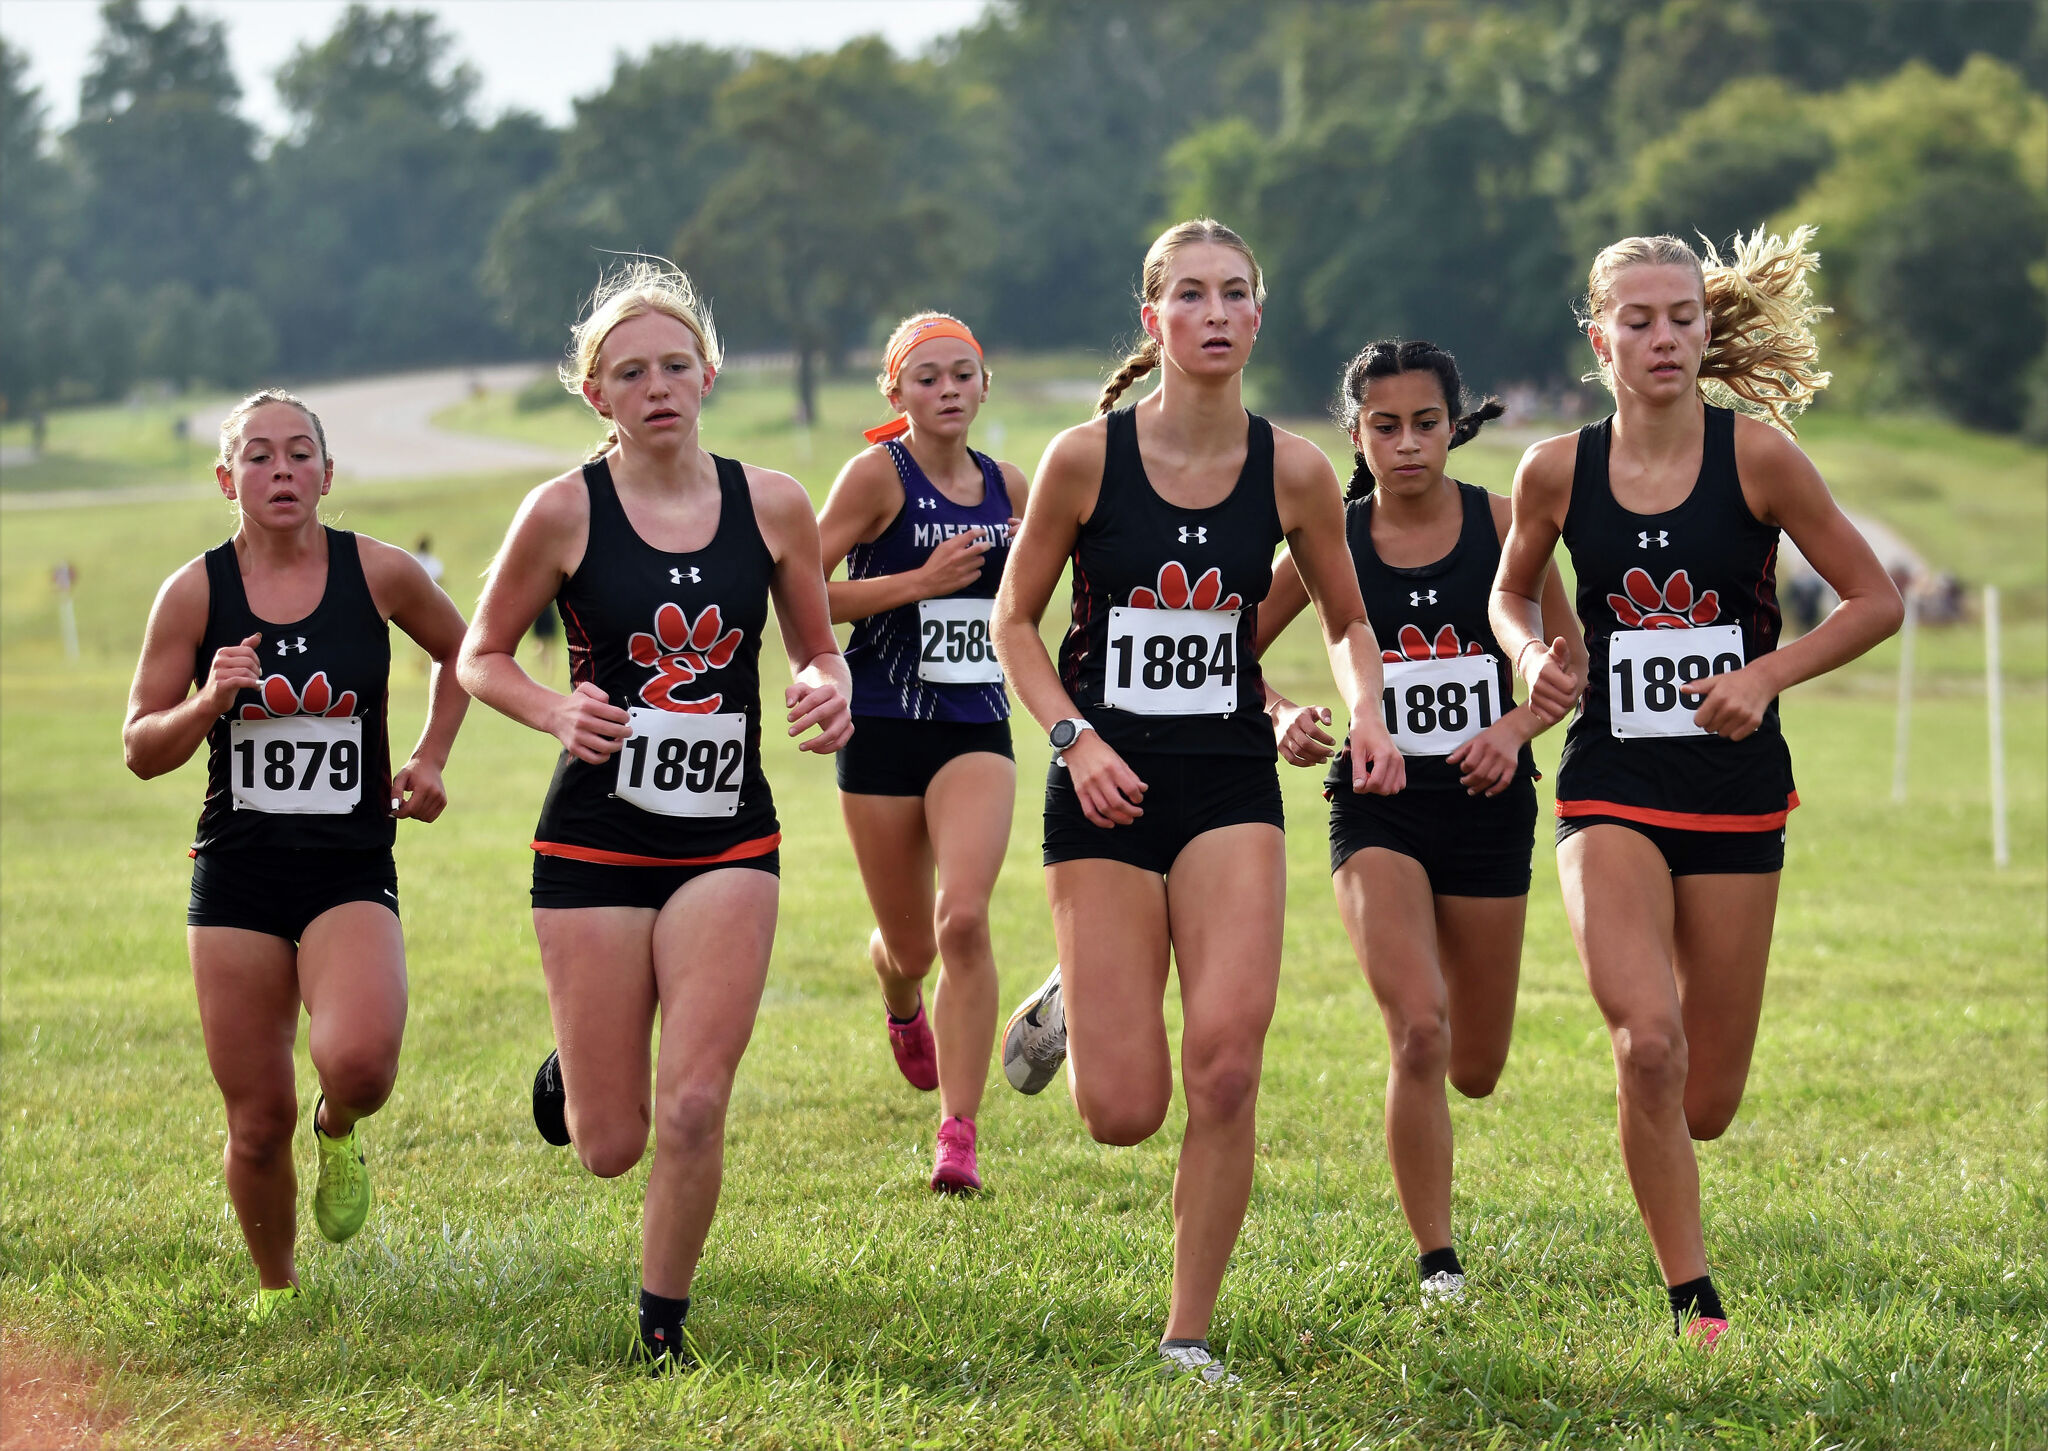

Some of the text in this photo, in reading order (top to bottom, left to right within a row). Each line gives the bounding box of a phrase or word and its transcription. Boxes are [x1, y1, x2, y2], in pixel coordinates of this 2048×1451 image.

[1111, 633, 1236, 690] 1884
[1382, 680, 1492, 734] 1881
[234, 739, 360, 791] 1879
[626, 735, 742, 793] 1892
